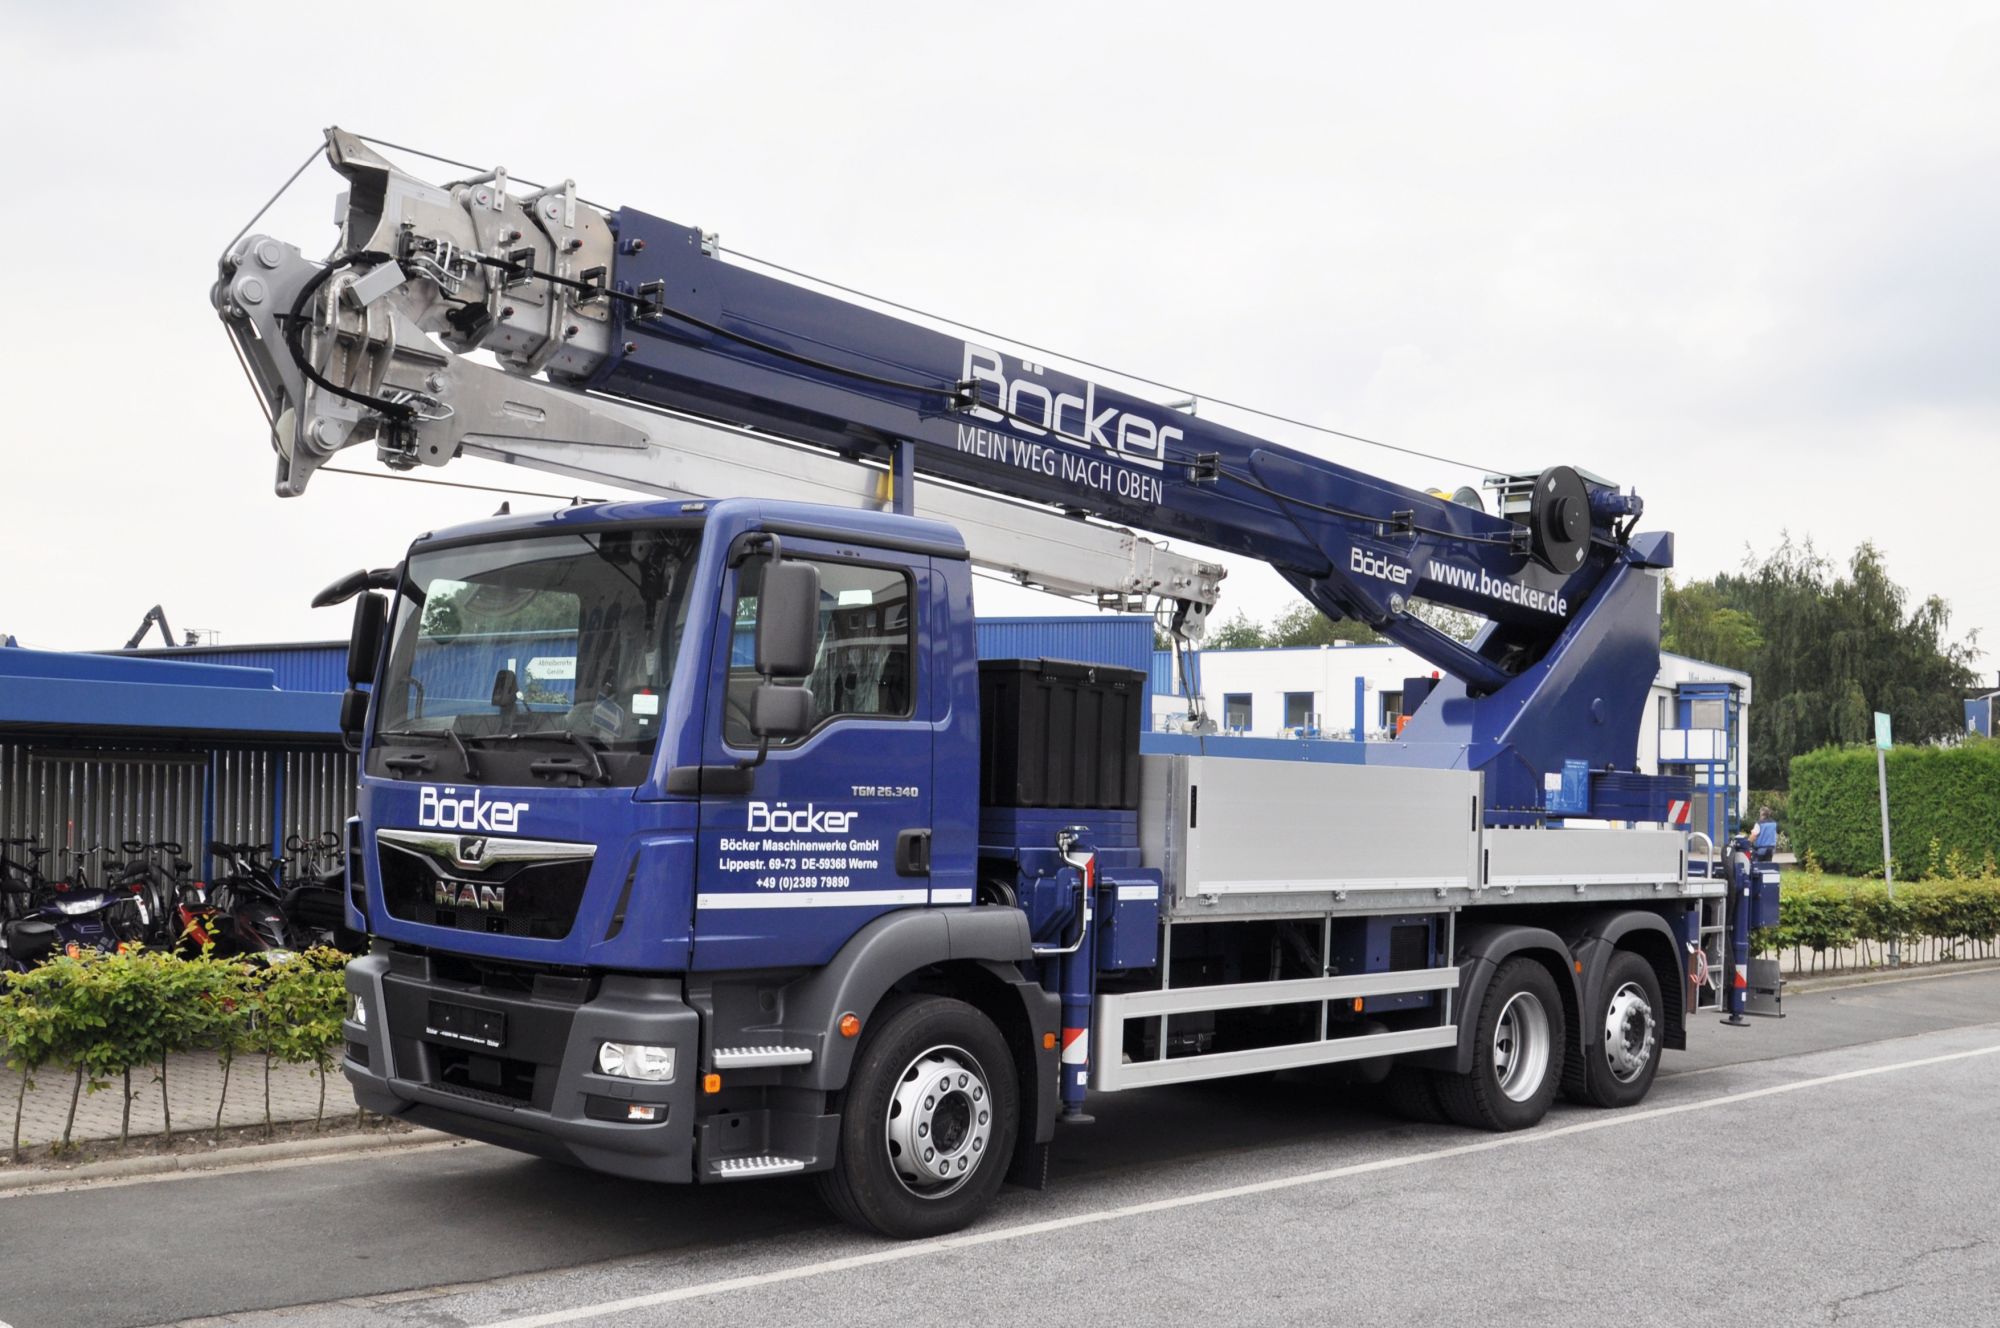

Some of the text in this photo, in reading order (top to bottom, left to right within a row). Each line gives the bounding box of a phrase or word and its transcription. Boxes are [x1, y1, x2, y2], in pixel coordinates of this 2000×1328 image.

[961, 342, 1183, 470] Böcker
[957, 424, 1162, 505] MEIN WEG NACH OBEN
[1350, 547, 1412, 585] Böcker
[1429, 560, 1568, 617] www.boecker.de
[851, 786, 919, 798] TGM 26.340
[418, 786, 529, 832] Böcker
[747, 801, 858, 833] Böcker
[720, 838, 879, 851] Böcker Maschinenwerke GmbH
[719, 858, 878, 872] Lippestr. 69-73 DE-59368 Werne
[435, 880, 505, 912] MAN
[756, 876, 850, 891] +49 (0)2389 79890
